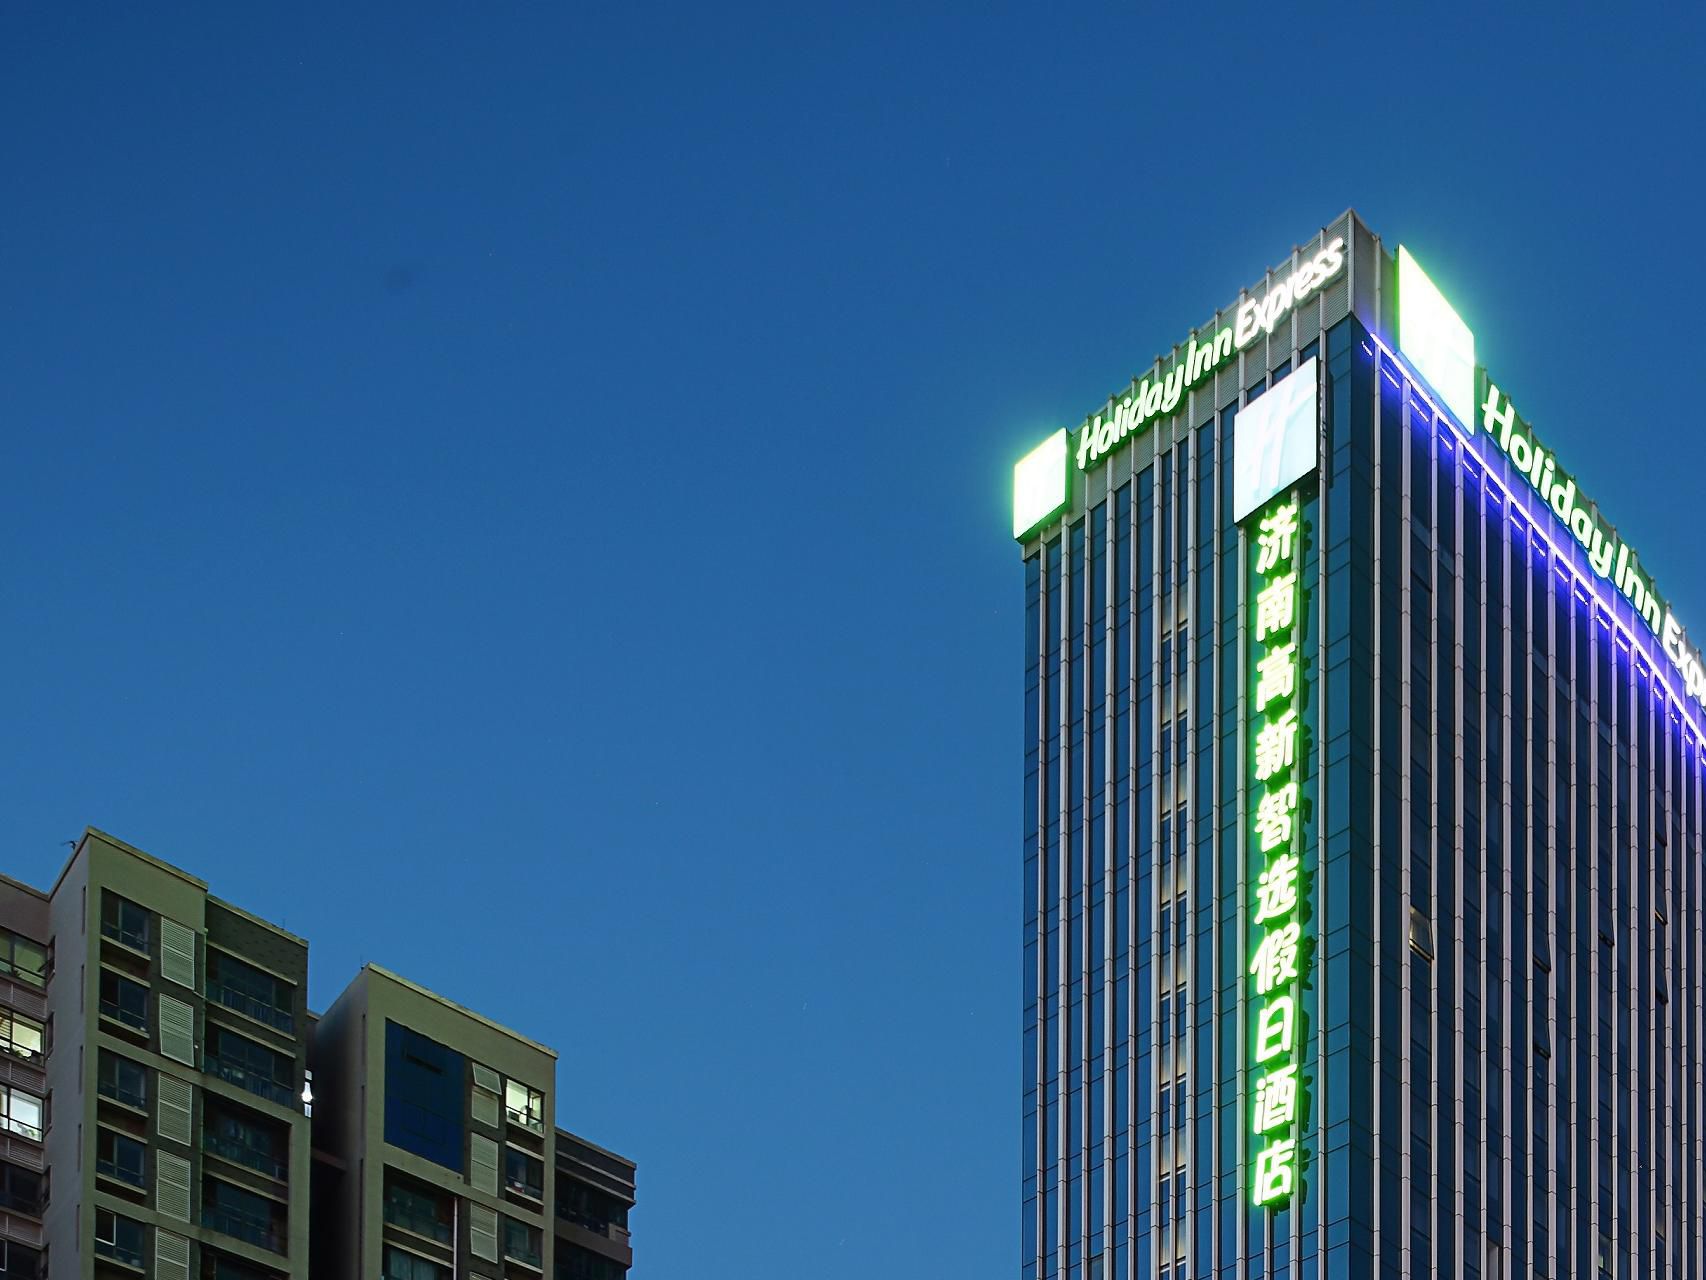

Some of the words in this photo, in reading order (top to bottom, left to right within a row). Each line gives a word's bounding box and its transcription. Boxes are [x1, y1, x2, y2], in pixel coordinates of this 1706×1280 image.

[1075, 365, 1185, 470] Holiday
[1184, 327, 1233, 387] Inn
[1234, 237, 1344, 348] Express
[1481, 384, 1614, 578] Holiday
[1614, 543, 1661, 635] Inn
[1249, 503, 1300, 1207] 济南高新智选假日酒店
